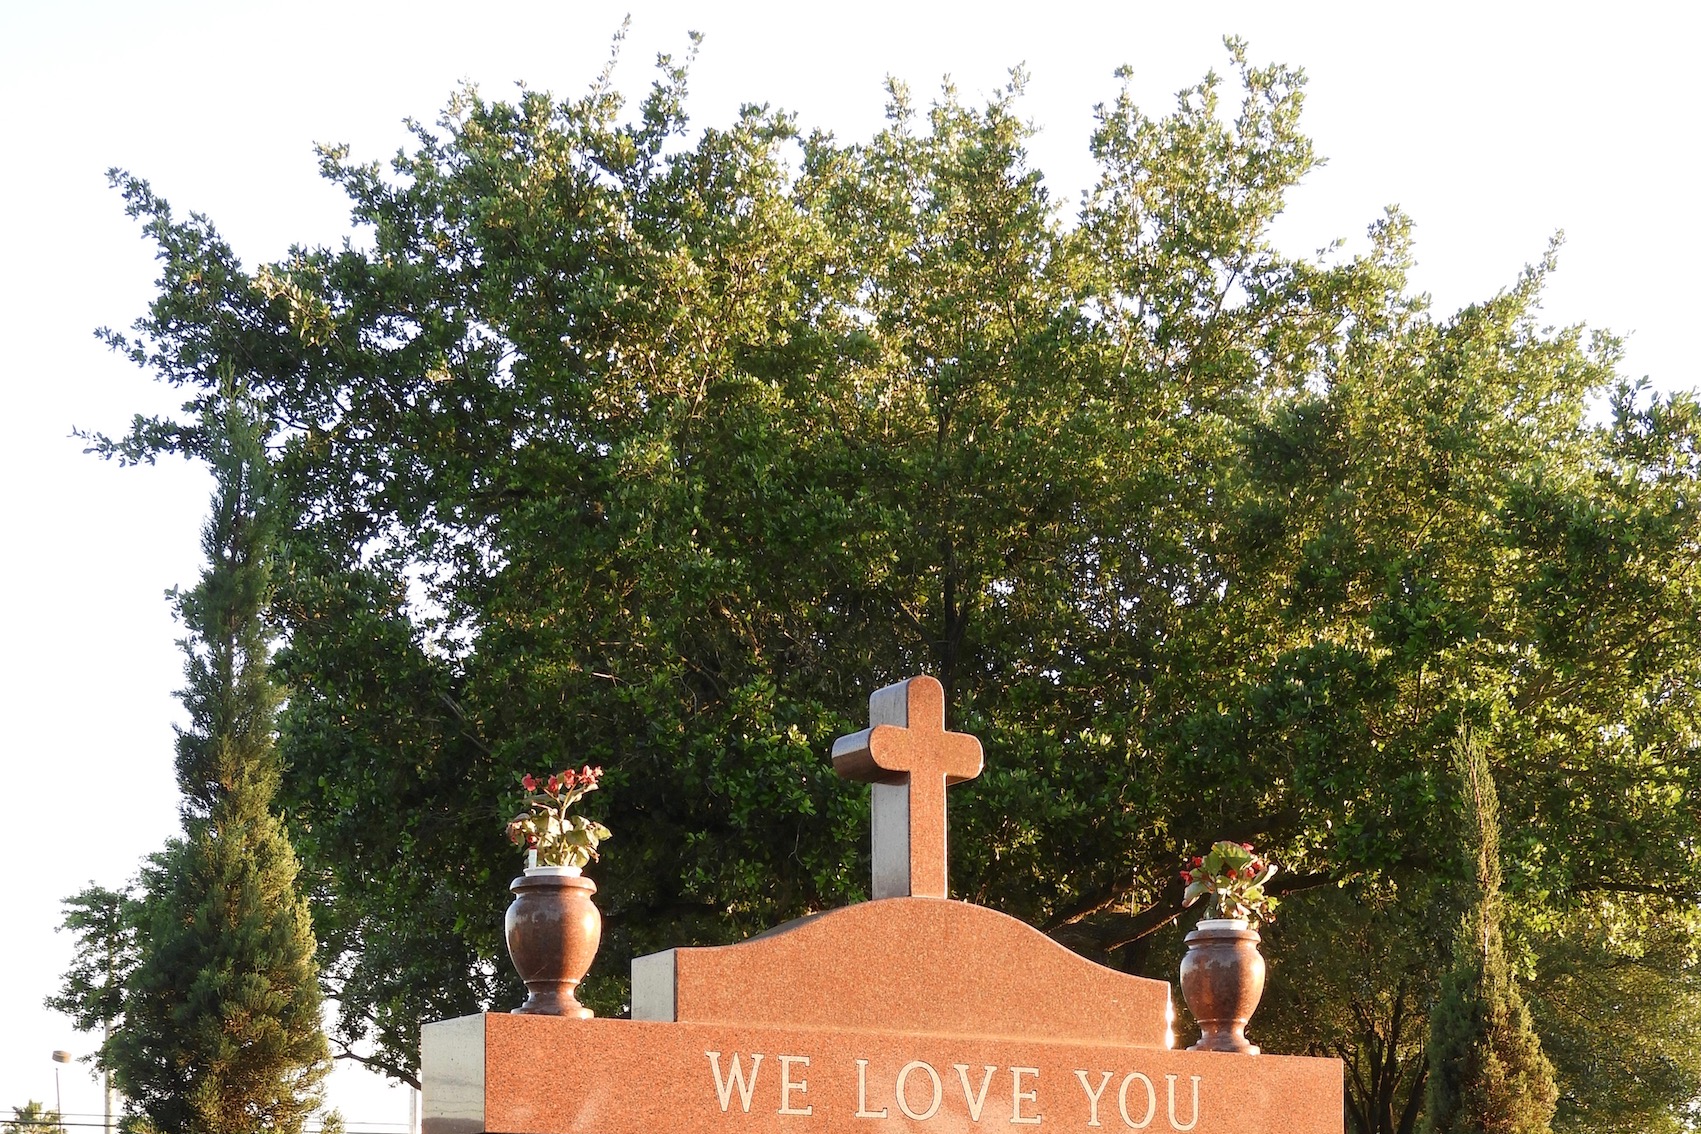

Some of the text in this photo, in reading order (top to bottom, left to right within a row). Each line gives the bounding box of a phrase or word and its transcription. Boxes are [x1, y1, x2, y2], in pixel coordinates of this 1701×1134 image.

[705, 1051, 1202, 1132] WE LOVE YOU
